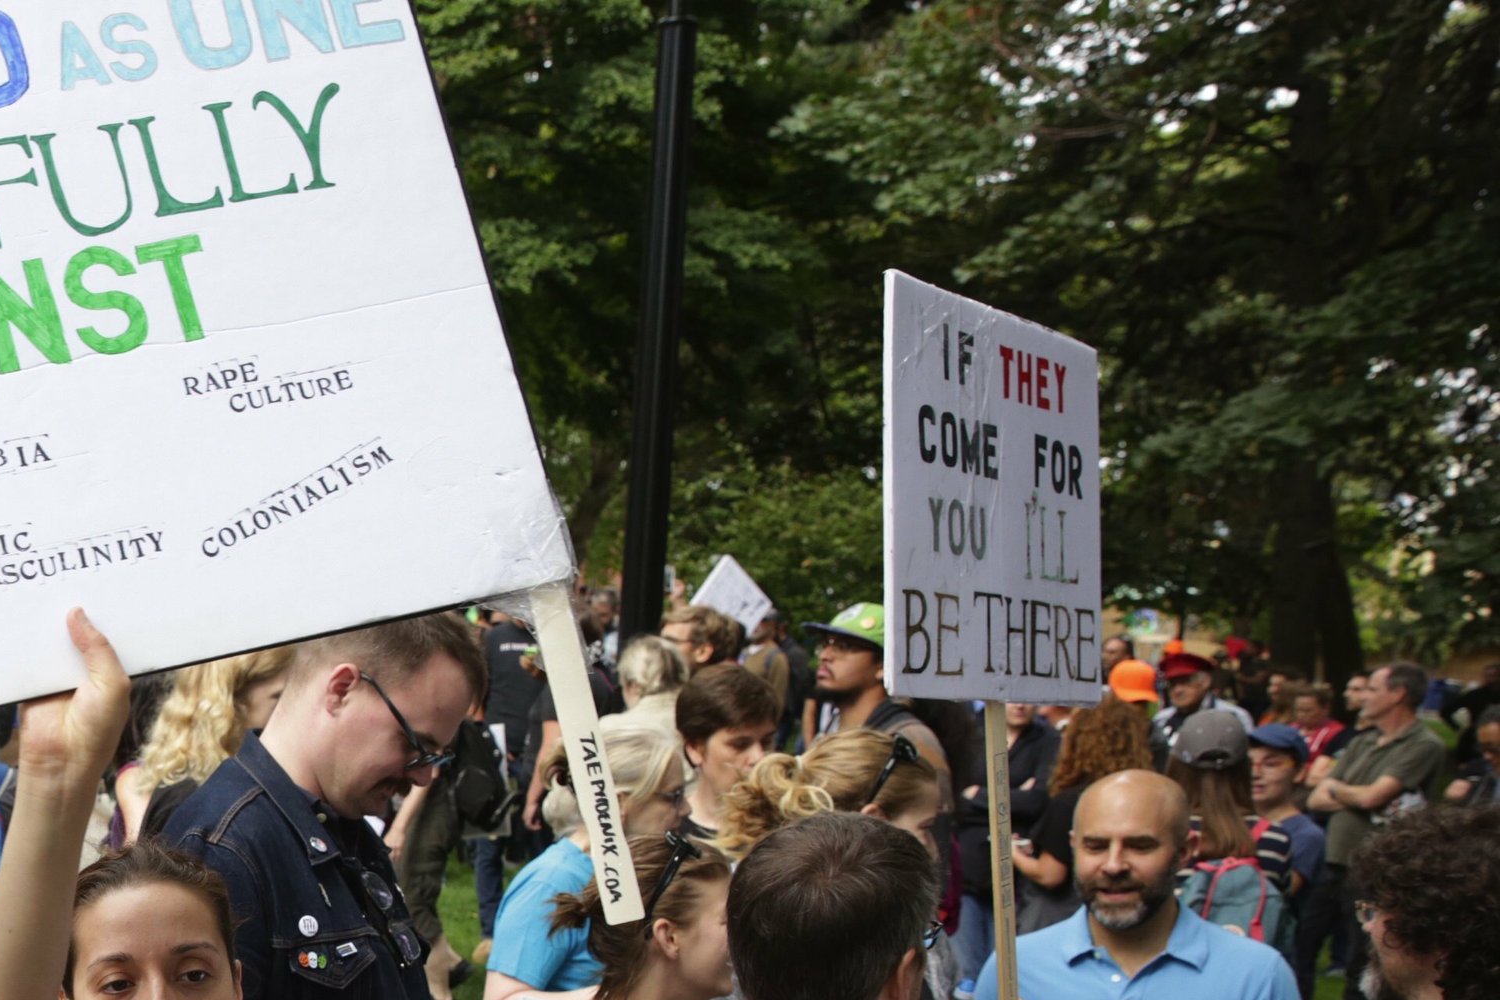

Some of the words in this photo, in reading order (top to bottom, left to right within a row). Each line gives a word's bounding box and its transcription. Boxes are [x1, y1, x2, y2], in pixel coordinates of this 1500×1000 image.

[59, 12, 158, 90] AS
[183, 362, 259, 396] RAPE
[229, 369, 354, 413] CULTURE
[942, 322, 975, 386] IF
[1000, 344, 1067, 413] THEY
[918, 404, 999, 480] COME
[1034, 433, 1083, 500] FOR
[201, 445, 395, 559] COLONIALISM
[928, 496, 987, 560] YOU
[902, 588, 964, 676] BE
[973, 591, 1098, 684] THERE
